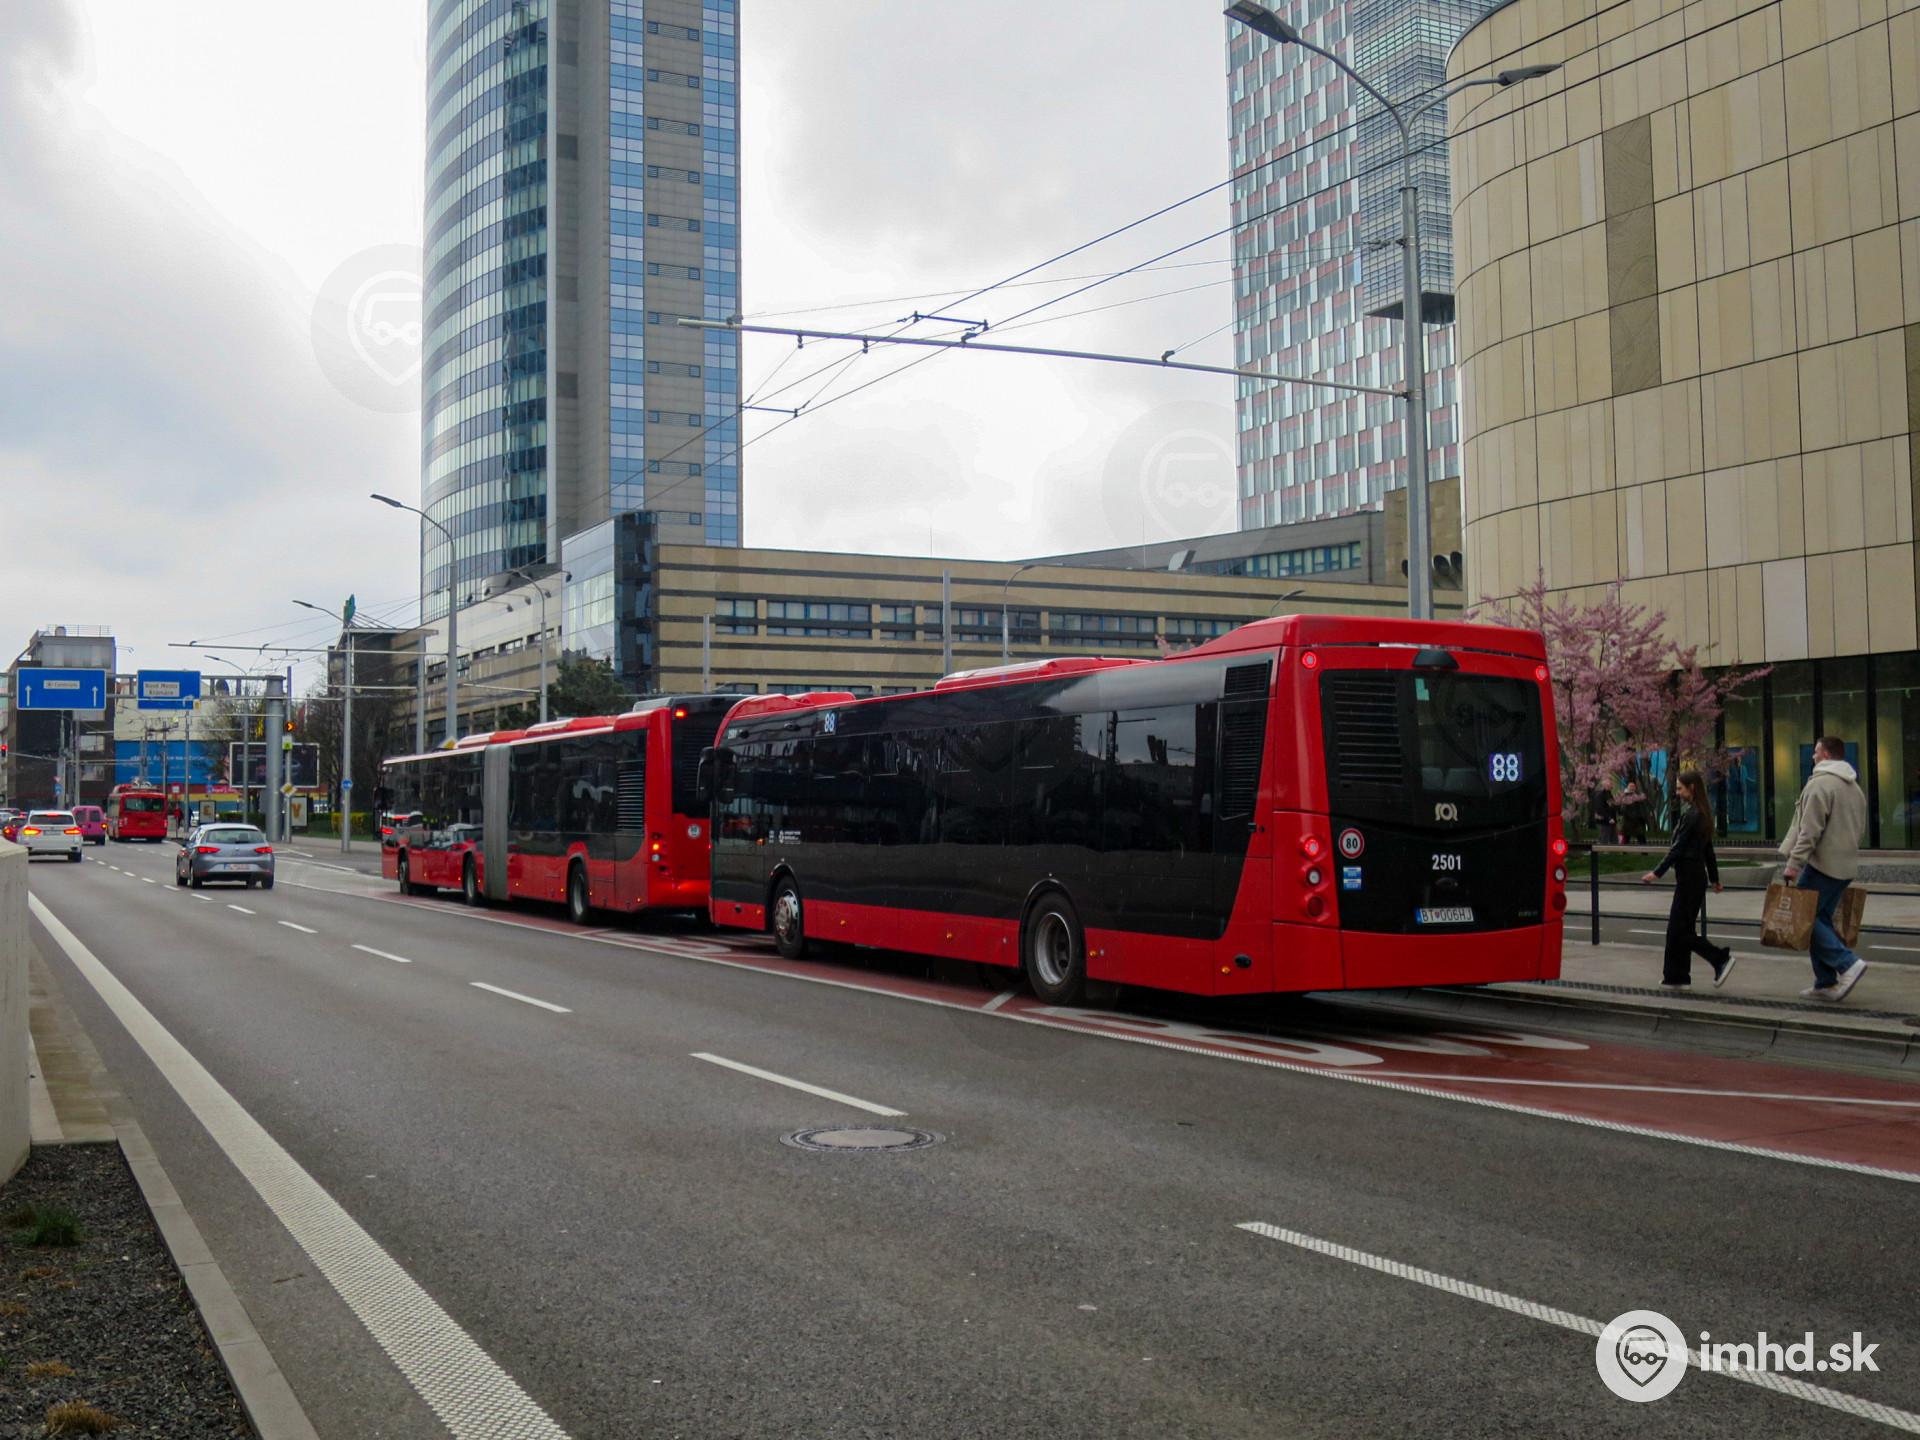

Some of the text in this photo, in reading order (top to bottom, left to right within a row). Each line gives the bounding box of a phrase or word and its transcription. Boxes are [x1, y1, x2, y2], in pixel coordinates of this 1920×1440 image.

[824, 713, 835, 733] 88
[1493, 753, 1519, 781] 88
[1346, 838, 1358, 849] 80
[1432, 854, 1461, 870] 2501
